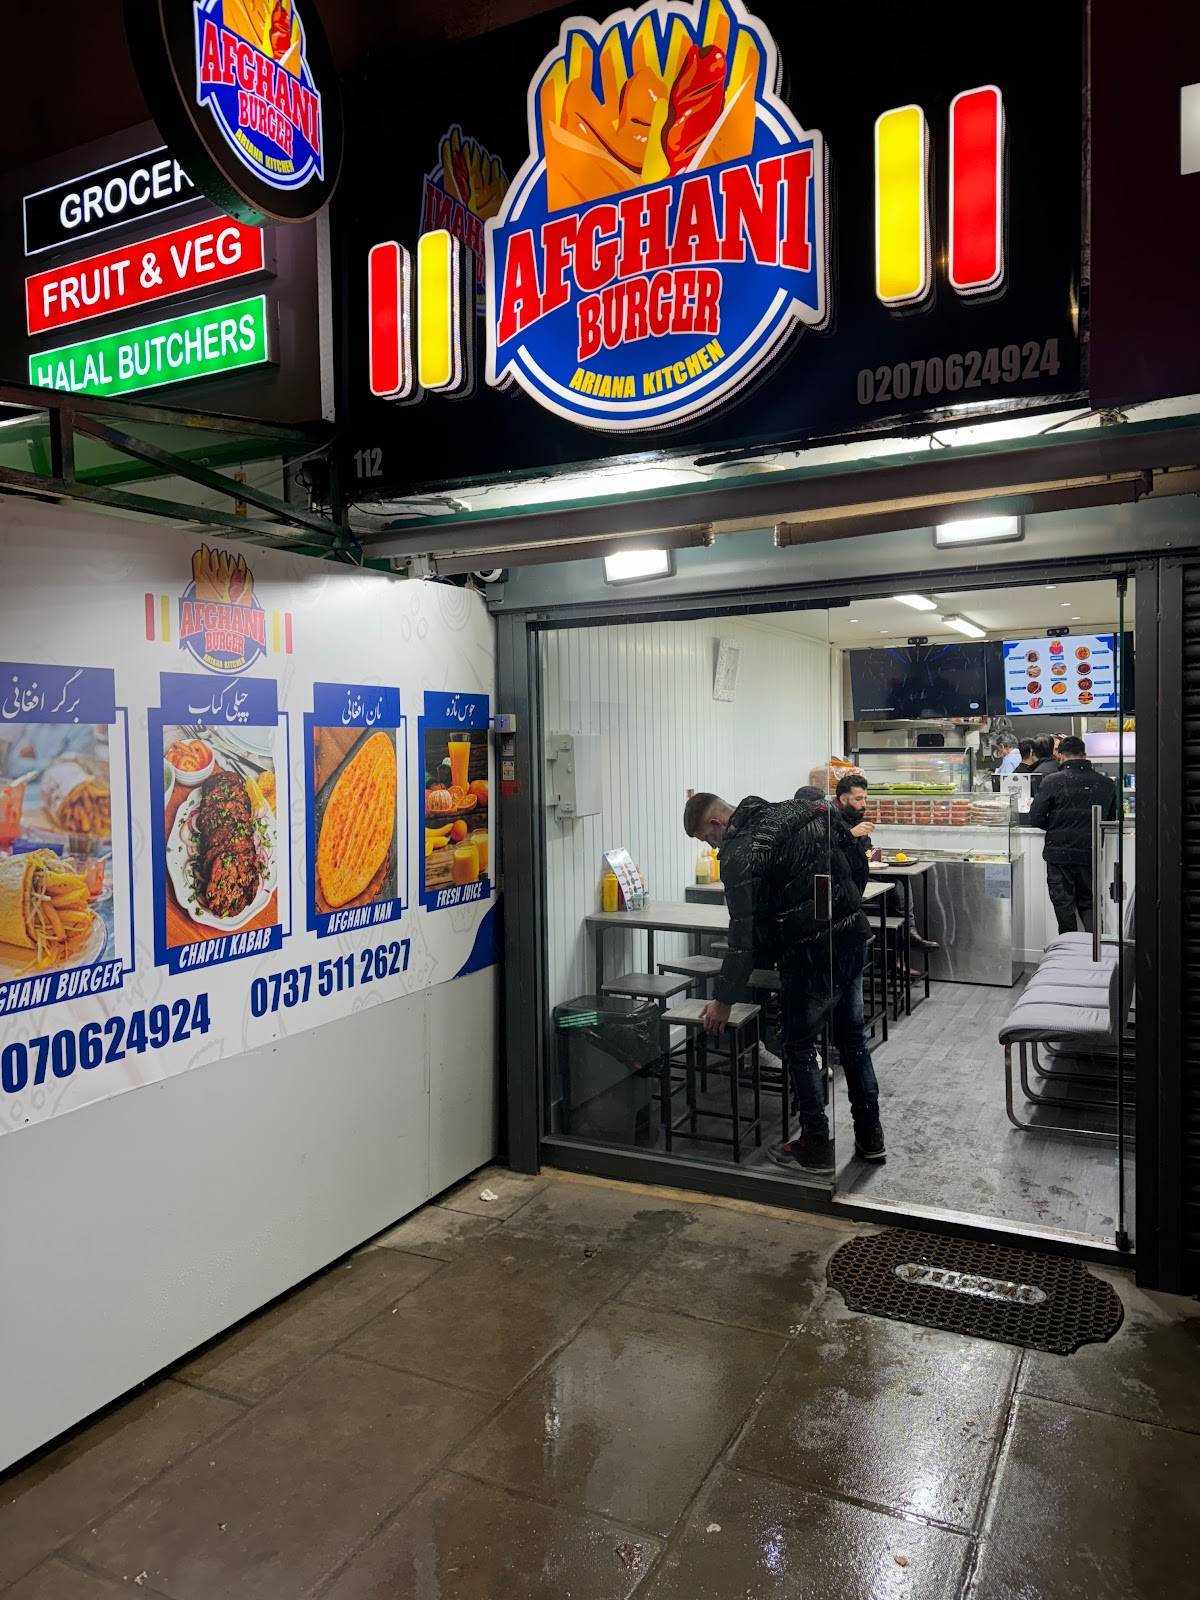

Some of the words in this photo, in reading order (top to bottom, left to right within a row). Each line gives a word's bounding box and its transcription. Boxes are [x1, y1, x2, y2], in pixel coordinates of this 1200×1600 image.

[201, 19, 320, 156] AFGHANI
[235, 129, 263, 164] ARIANA
[265, 156, 294, 173] KITCHEN
[237, 90, 294, 159] BURGER
[43, 260, 130, 318] FRUIT
[139, 252, 163, 289] &
[170, 227, 242, 279] VEG
[498, 149, 814, 347] AFGHANI
[577, 267, 723, 362] BURGER
[38, 351, 112, 392] HALAL
[118, 313, 255, 380] BUTCHERS
[569, 367, 636, 398] ARIANA
[643, 338, 725, 396] KITCHEN
[857, 338, 1060, 405] 02070624924
[353, 447, 383, 479] 112
[180, 602, 266, 646] AFGHANI
[205, 631, 245, 656] BURGER
[327, 905, 372, 934] AFGHANI
[373, 901, 393, 923] NAN
[436, 886, 461, 908] FRESH
[461, 881, 483, 902] JUICE
[55, 961, 123, 1000] BURGER
[179, 941, 226, 970] CHAPLI
[229, 928, 272, 956] KABAB
[250, 963, 314, 1018] 0737
[318, 952, 355, 997] 511
[360, 938, 411, 985] 2627
[1, 992, 211, 1094] 070624924
